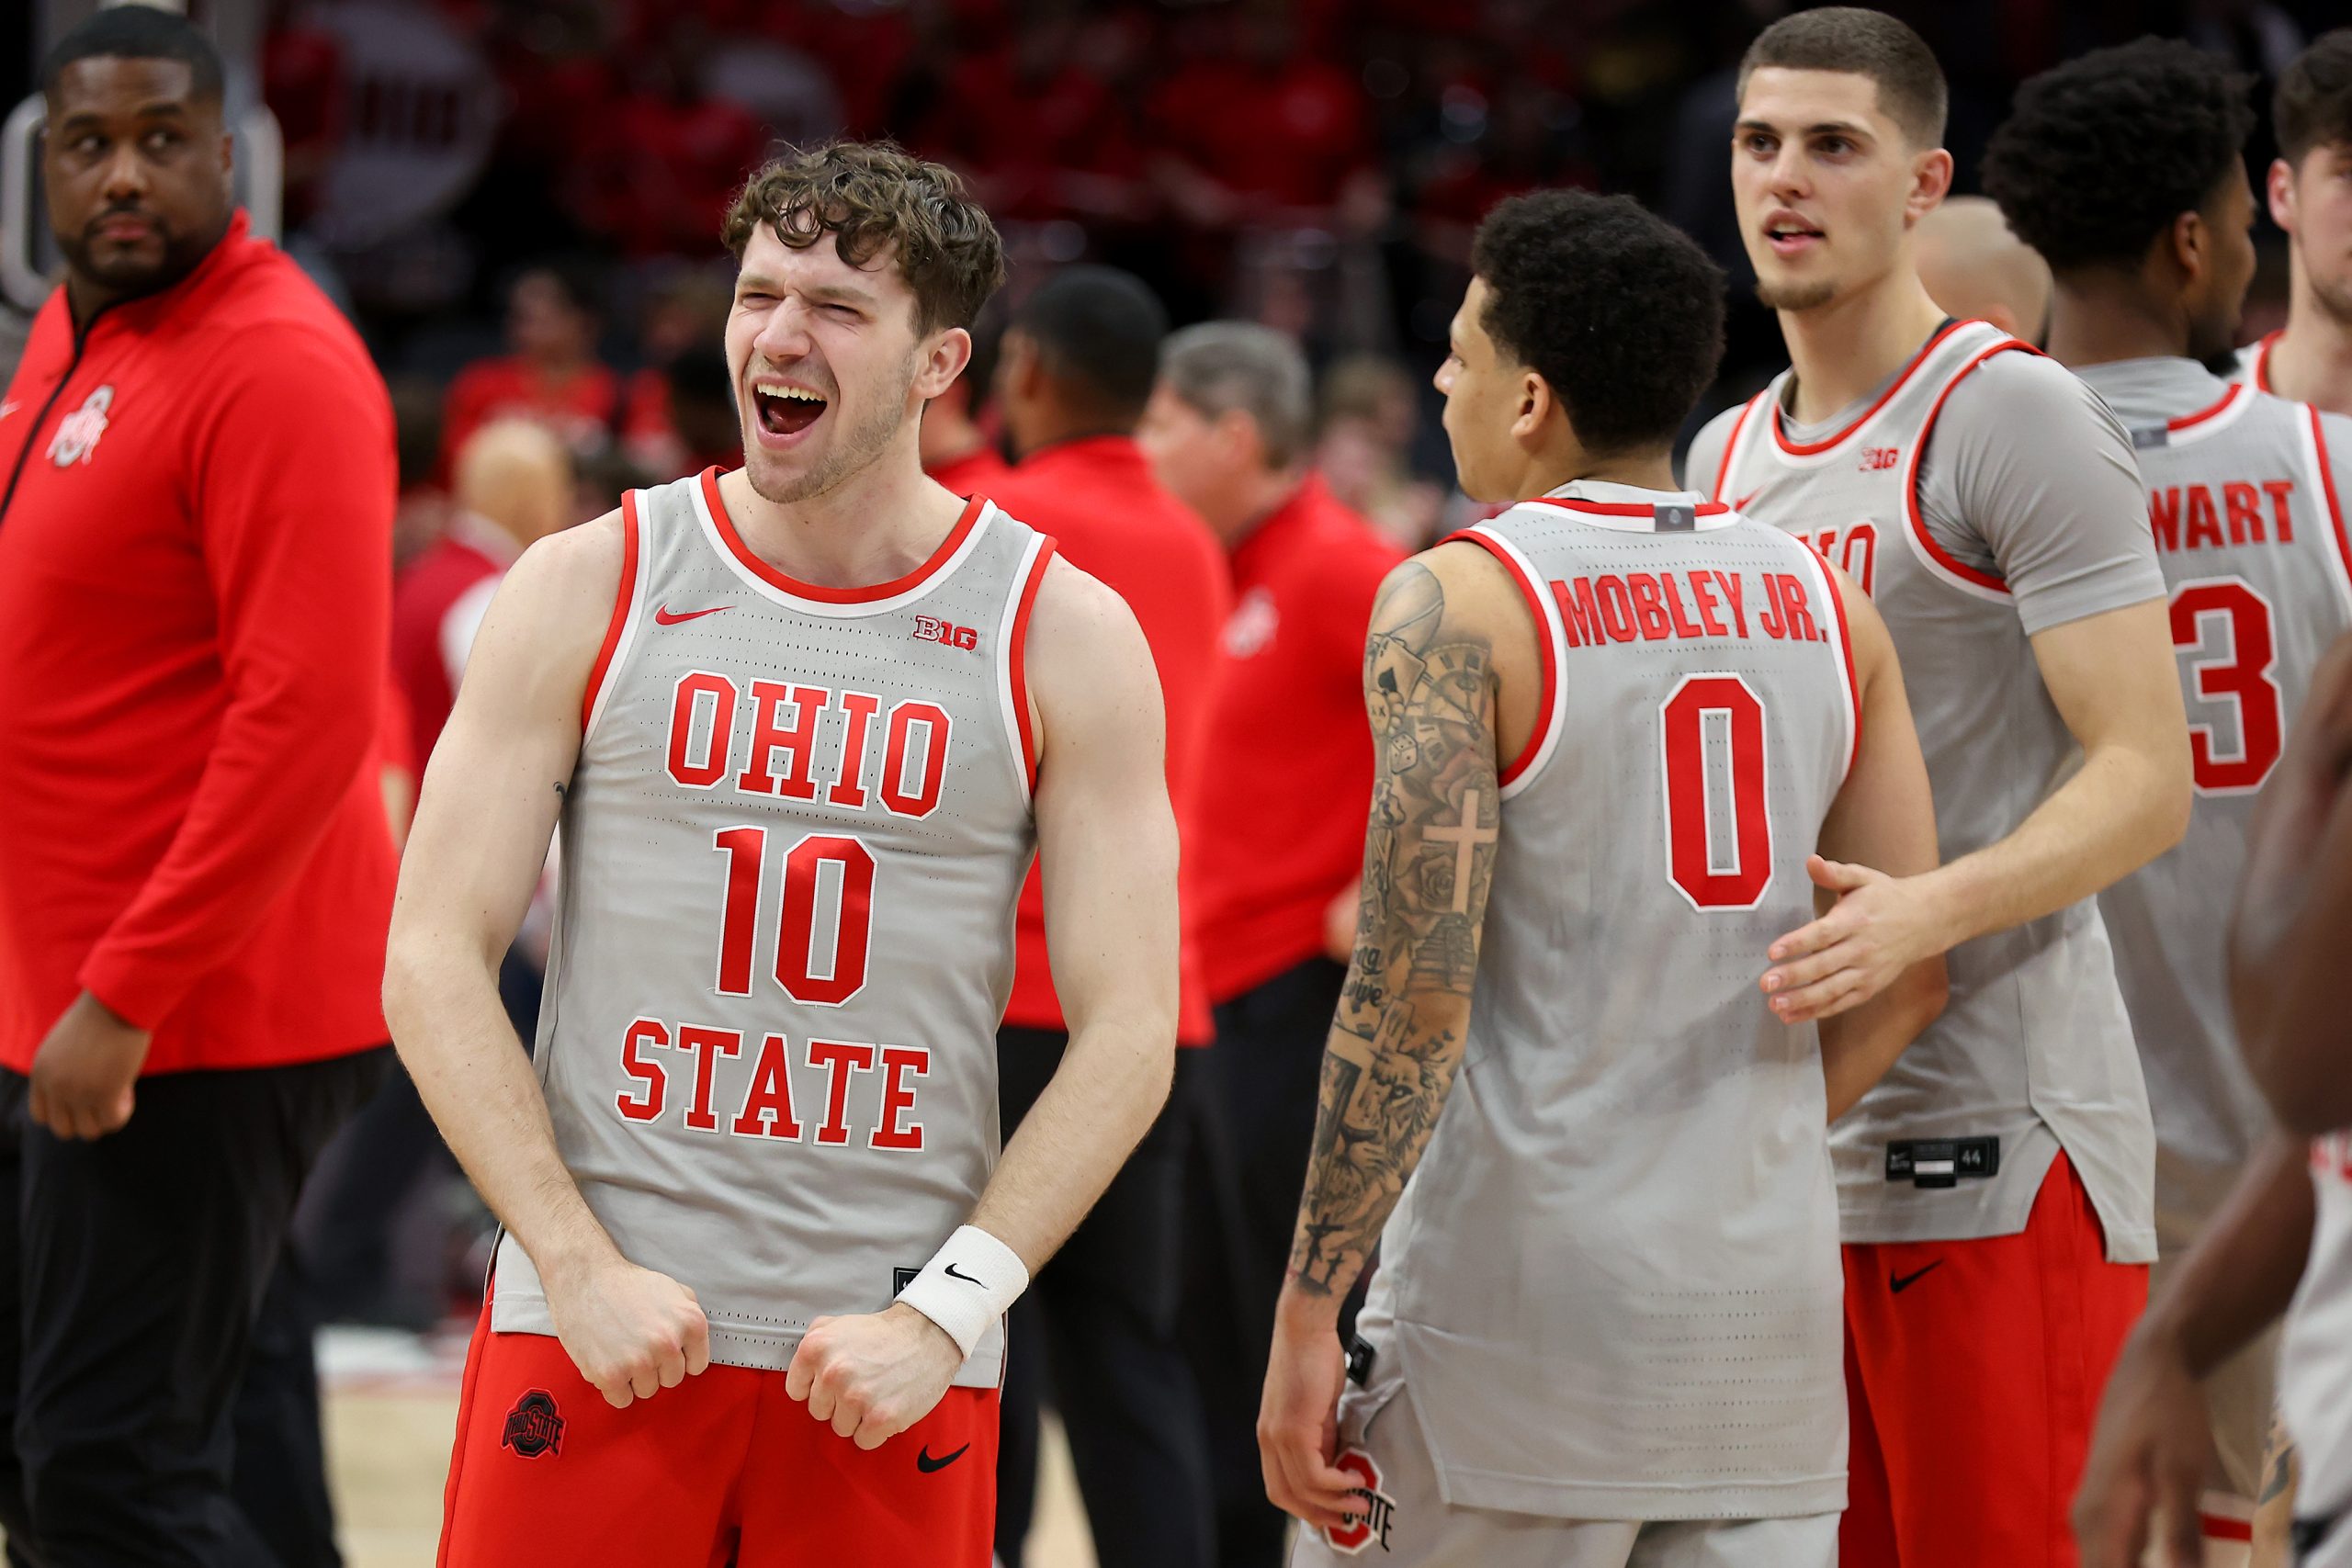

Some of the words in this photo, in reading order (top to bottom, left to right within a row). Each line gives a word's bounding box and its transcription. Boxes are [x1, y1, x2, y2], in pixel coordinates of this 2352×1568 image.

[1549, 570, 1749, 649] MOBLEY
[1759, 572, 1828, 644] JR.
[664, 669, 954, 821] OHIO
[2167, 574, 2286, 798] 3
[1658, 671, 1775, 914] 0
[712, 823, 878, 1008] 10
[614, 1015, 931, 1153] STATE
[1962, 1150, 1981, 1166] 44
